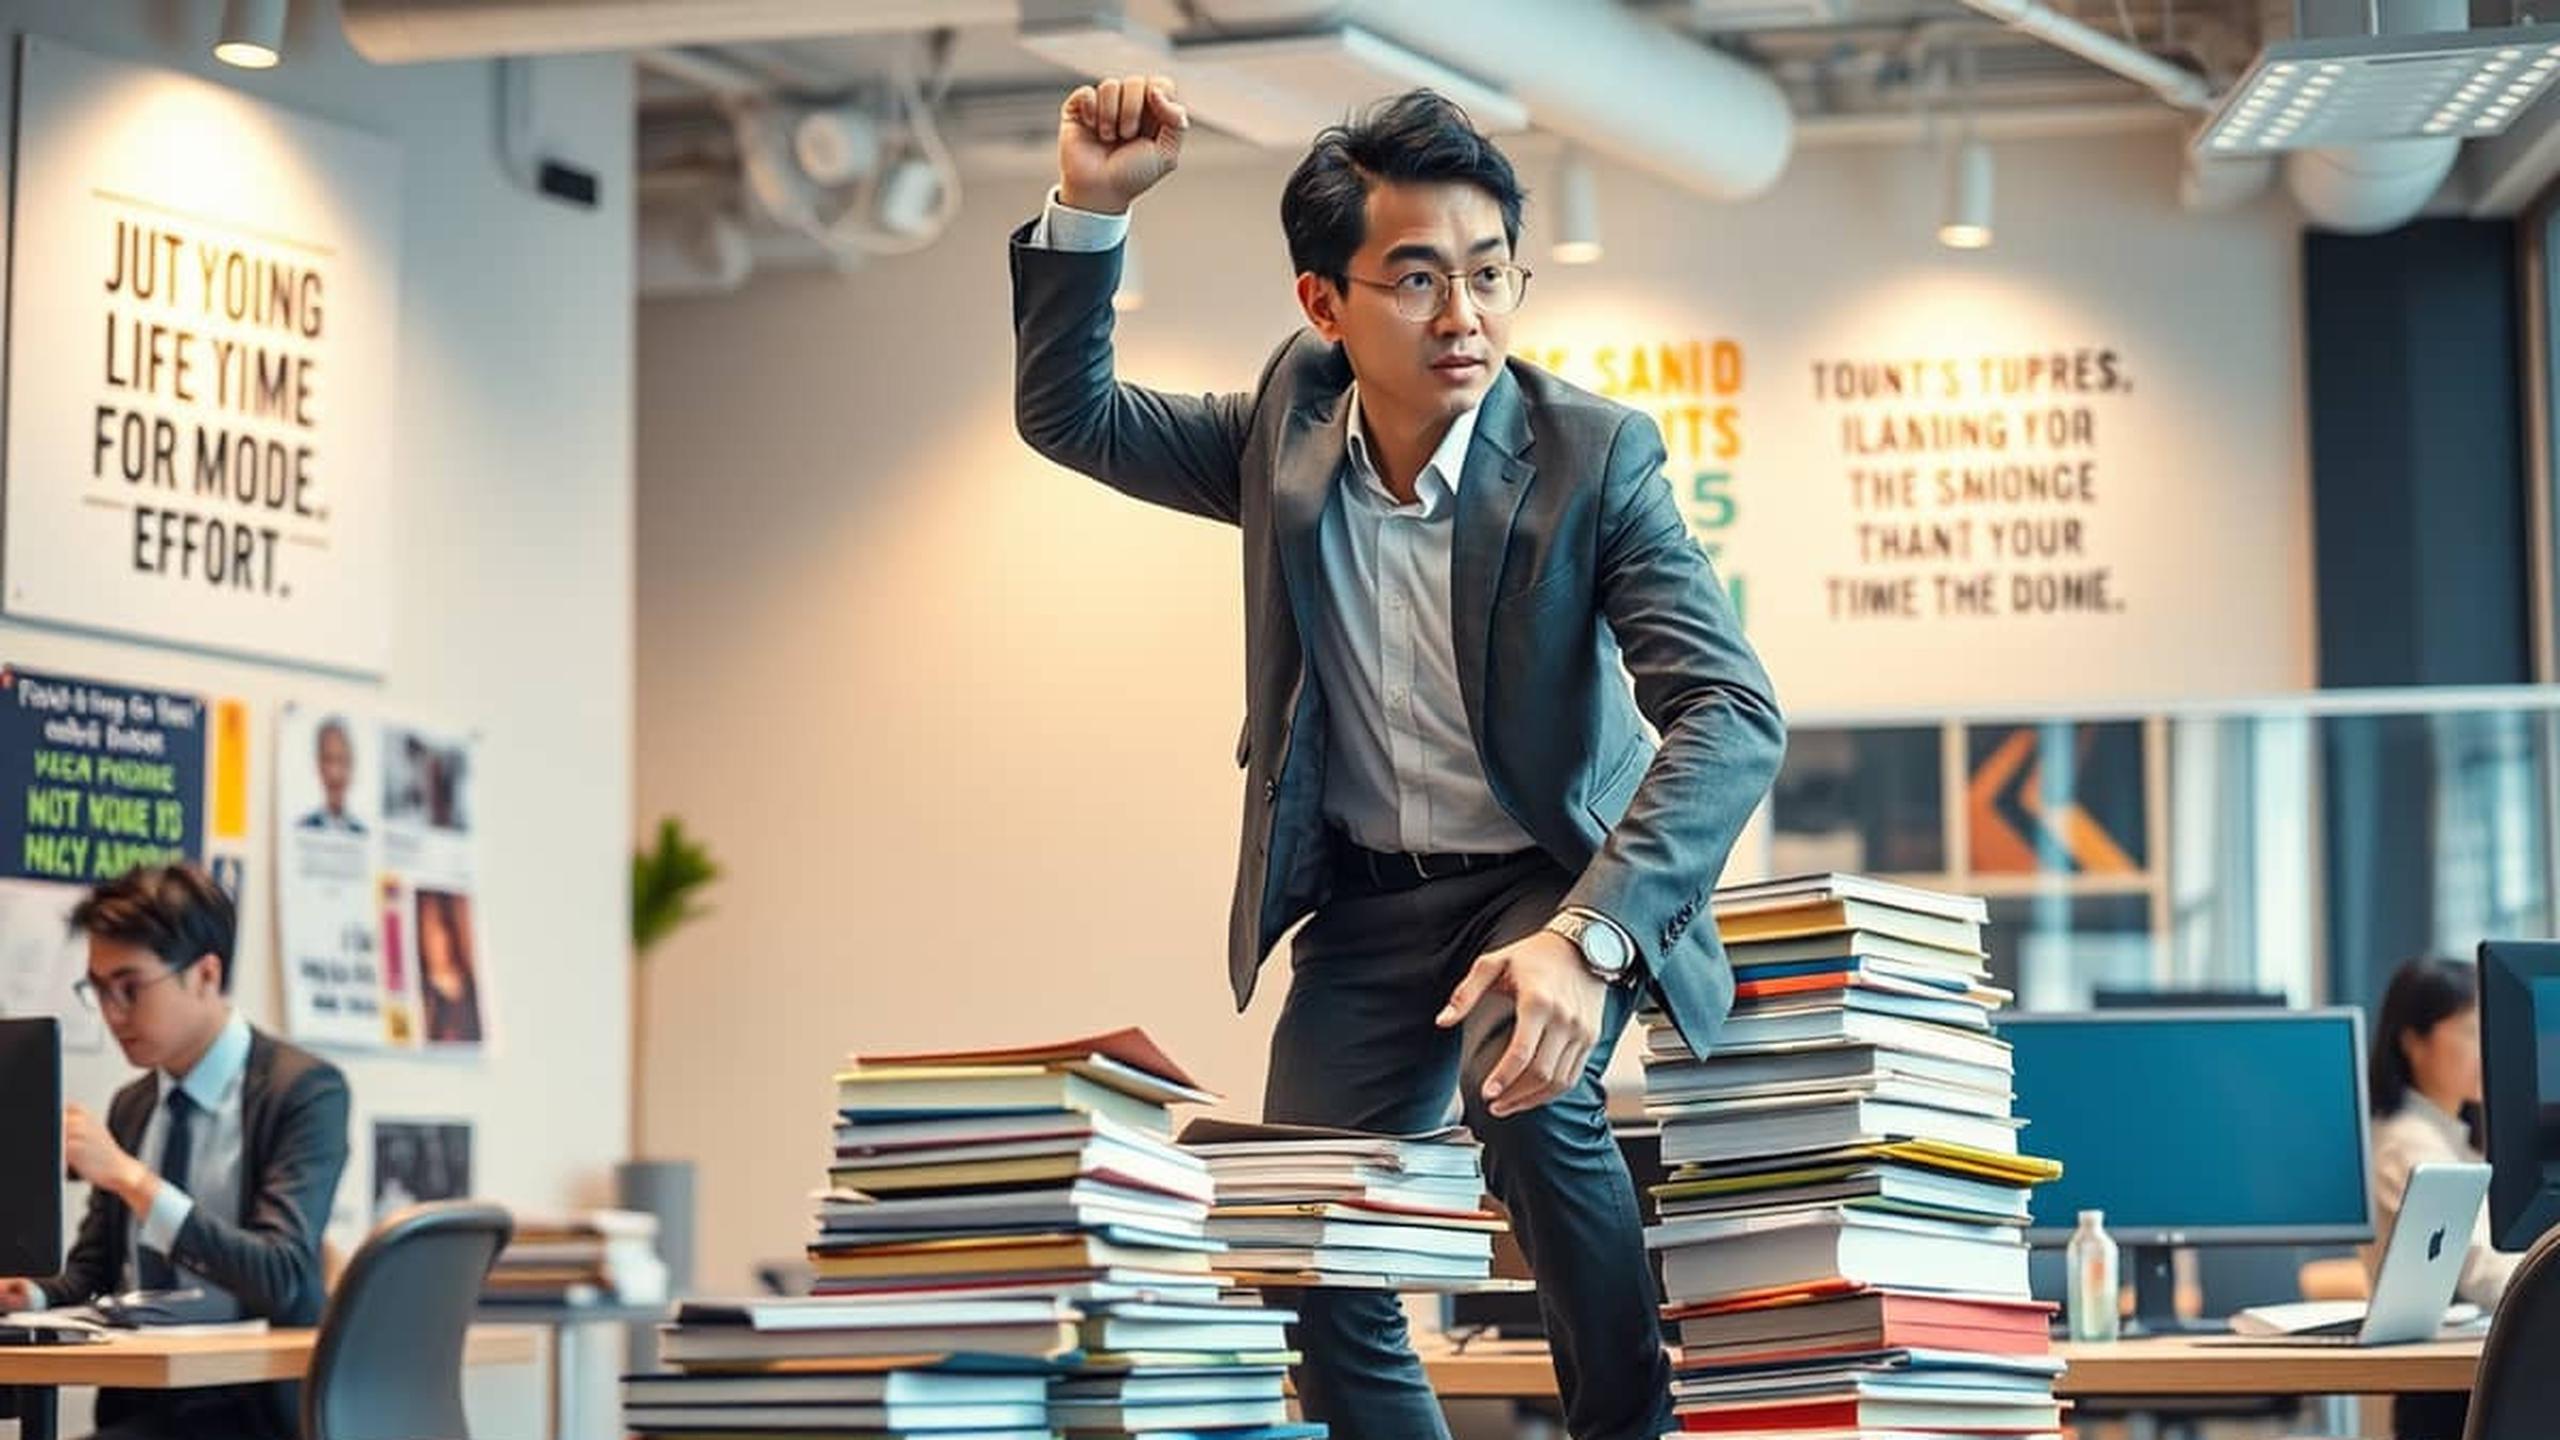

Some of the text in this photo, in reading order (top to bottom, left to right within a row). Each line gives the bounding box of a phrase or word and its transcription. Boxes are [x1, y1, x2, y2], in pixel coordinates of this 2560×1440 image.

[106, 221, 323, 339] JUT YOING
[106, 312, 314, 427] LIFE YIME
[94, 406, 329, 521] FOR MODE.
[1849, 468, 1915, 508] THE
[132, 505, 291, 600] EFFORT.
[1990, 518, 2082, 556] YOUR
[1933, 572, 1996, 616] THE
